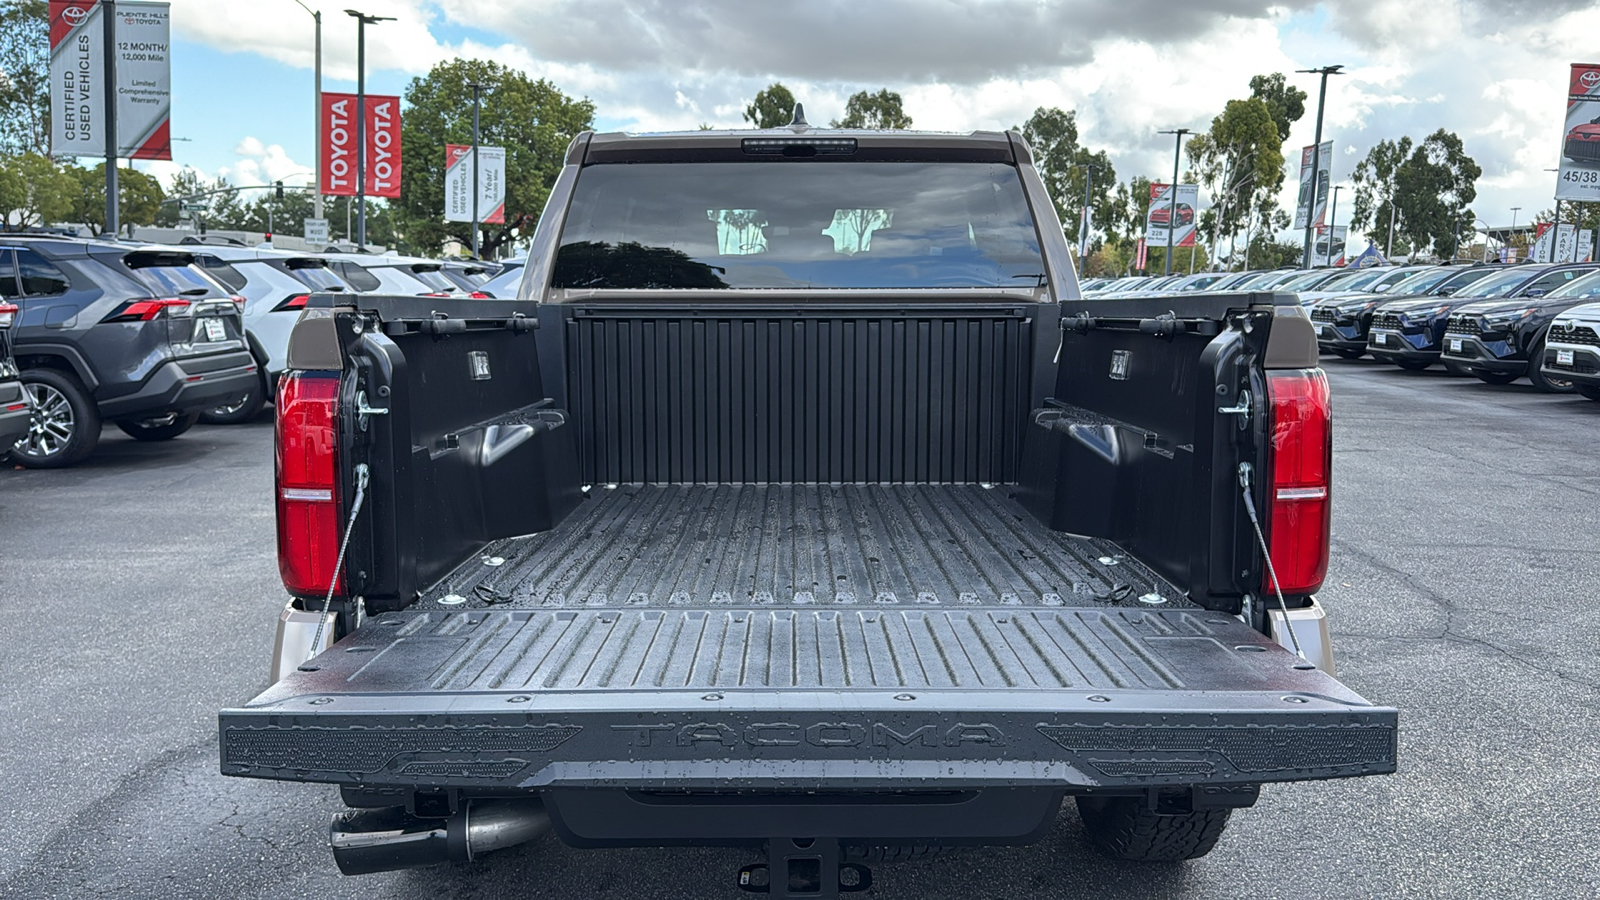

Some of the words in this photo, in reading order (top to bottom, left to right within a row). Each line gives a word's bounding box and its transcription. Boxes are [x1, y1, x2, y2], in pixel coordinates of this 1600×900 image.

[117, 42, 128, 51] 12
[130, 42, 168, 53] MONTH/
[122, 53, 146, 62] 12,000
[148, 54, 164, 62] Mile
[78, 34, 90, 101] VEHICLES
[118, 88, 170, 97] Comprehensive
[132, 79, 156, 87] Limited
[64, 70, 75, 141] CERTIFIED
[130, 97, 160, 105] Warranty
[80, 106, 91, 141] USED
[330, 99, 349, 190] TOYOTA
[374, 101, 392, 192] TOYOTA
[1563, 170, 1598, 183] 45/38
[611, 722, 1007, 748] TACOMA
